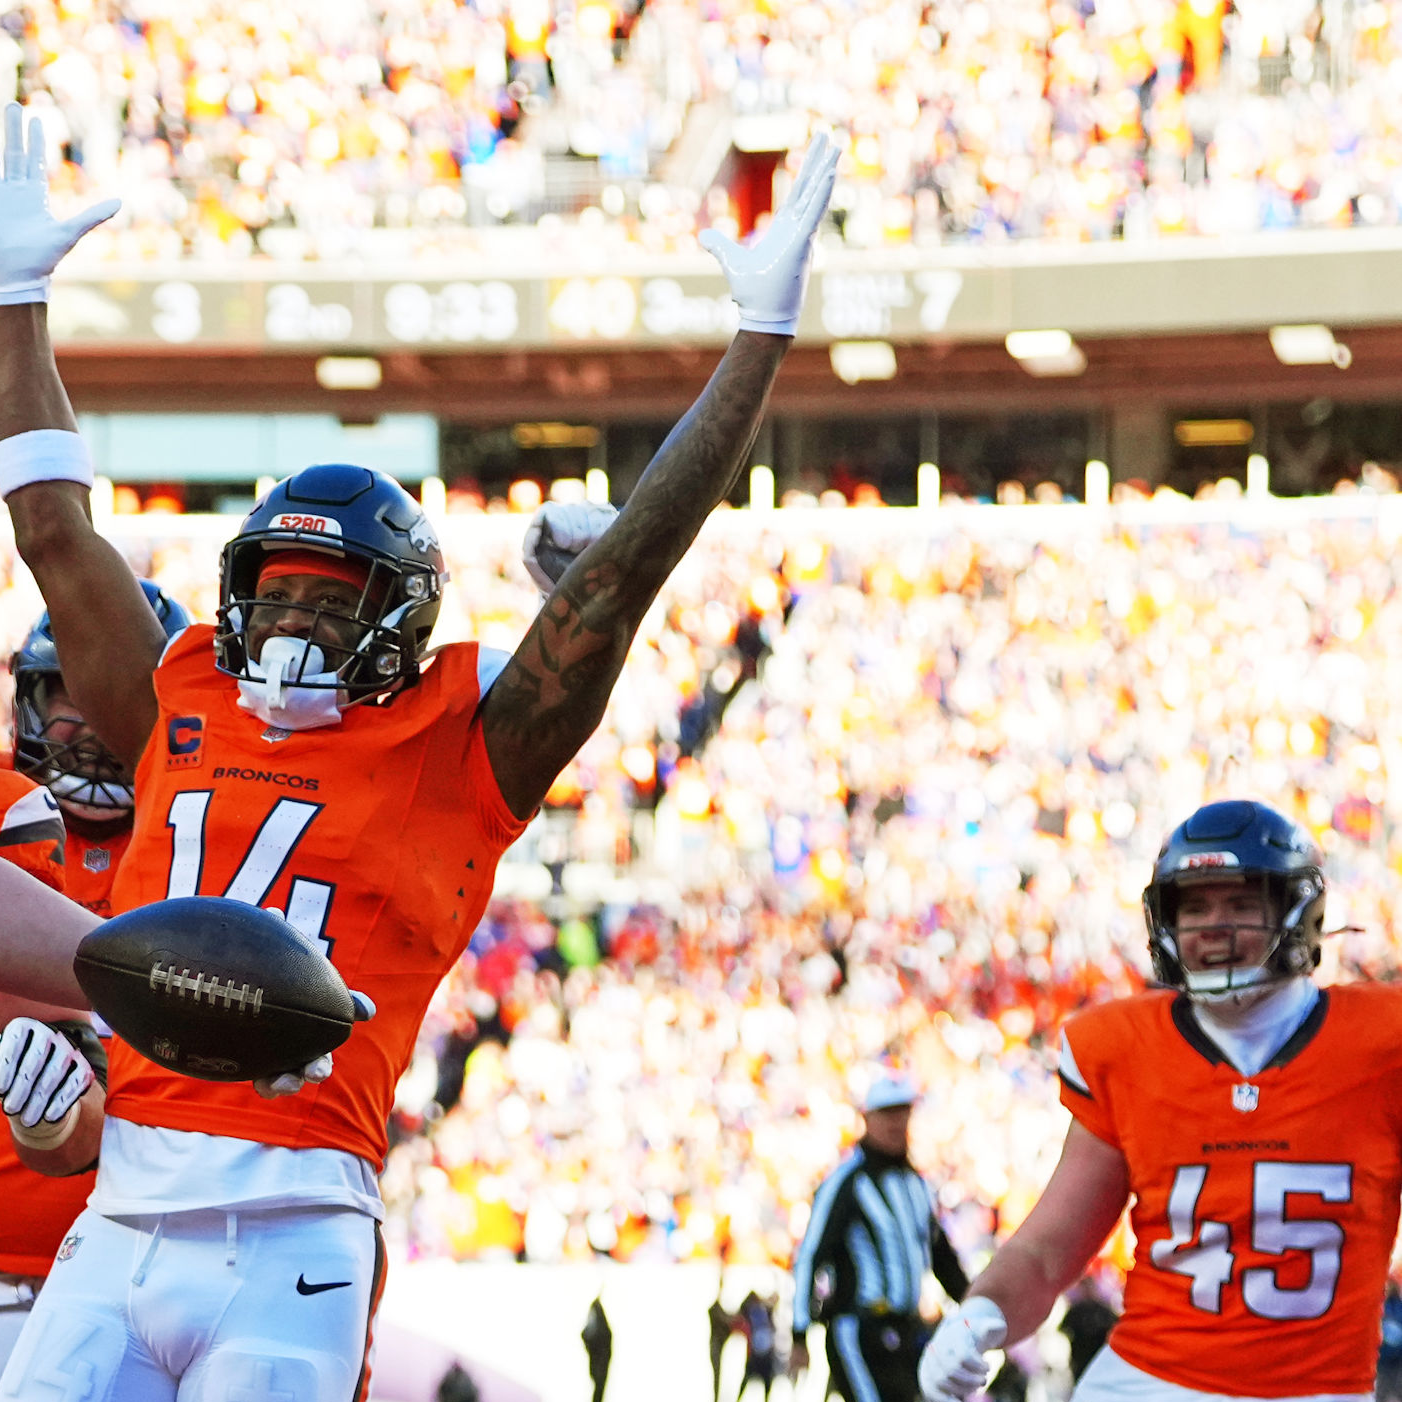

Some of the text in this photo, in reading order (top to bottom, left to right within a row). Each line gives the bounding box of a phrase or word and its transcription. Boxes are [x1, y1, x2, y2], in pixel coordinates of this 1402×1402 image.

[152, 281, 202, 343] 3
[915, 271, 963, 332] 7
[168, 716, 203, 755] C
[213, 767, 320, 791] BRONCOS
[166, 788, 336, 960] 14
[1150, 1160, 1353, 1320] 45
